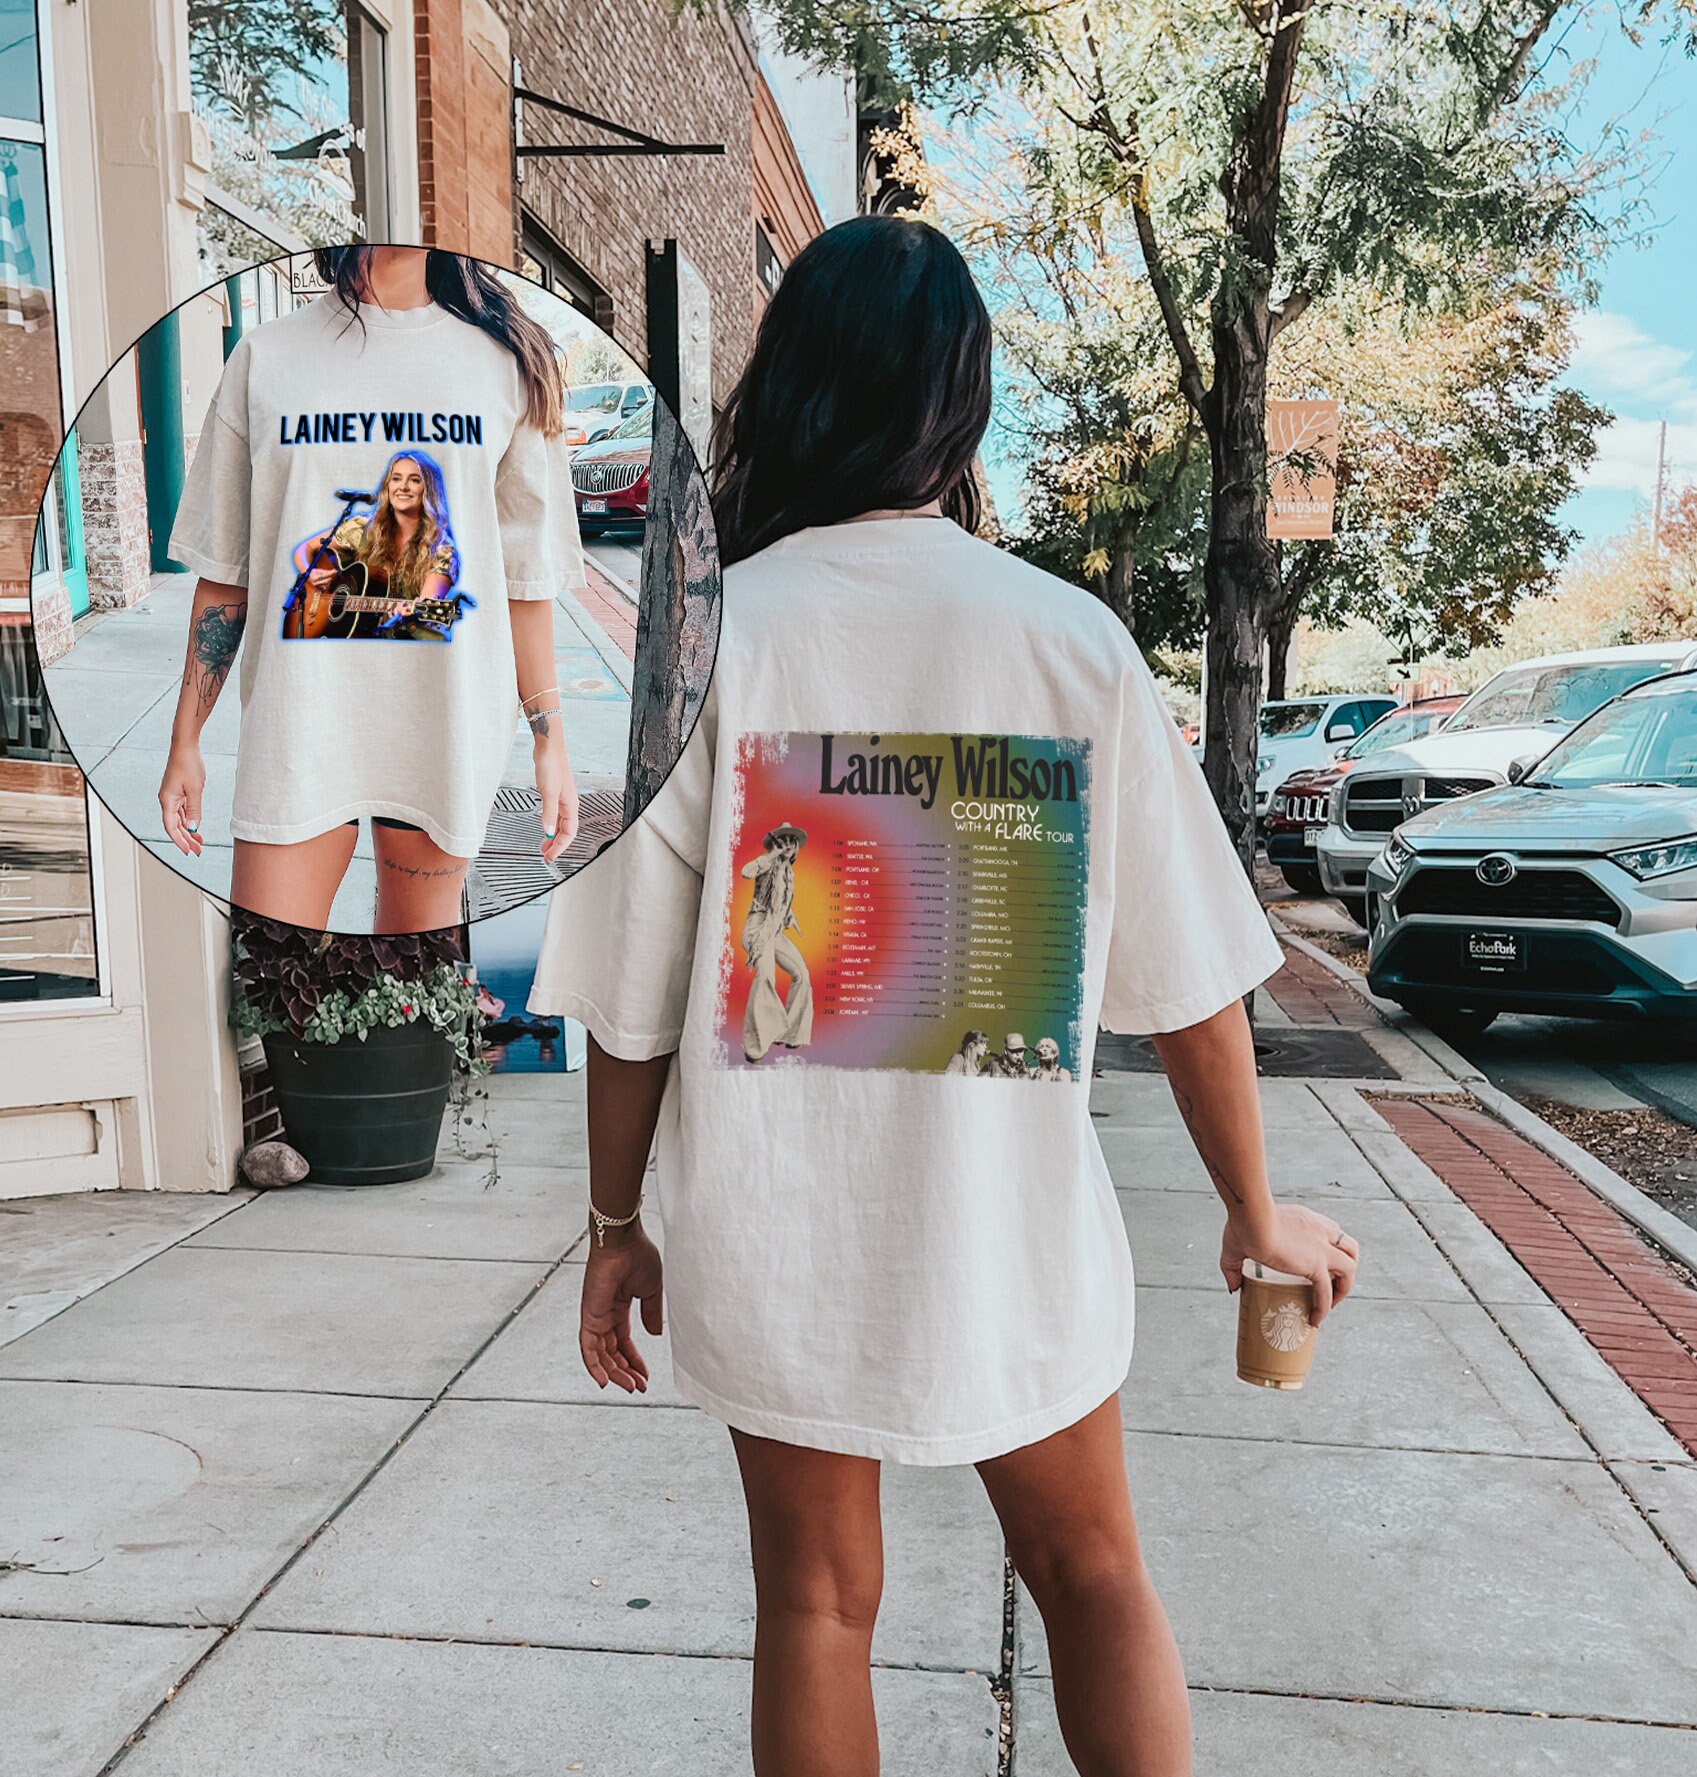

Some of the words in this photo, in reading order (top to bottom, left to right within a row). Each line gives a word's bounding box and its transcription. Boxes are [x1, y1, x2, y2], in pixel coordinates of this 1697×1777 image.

[293, 272, 328, 288] BLAC
[280, 412, 377, 445] LAINEY
[381, 412, 483, 446] WILSON
[819, 734, 944, 810] Lainey
[951, 736, 1078, 802] Wilson
[951, 801, 1040, 822] COUNTRY
[955, 821, 982, 833] WITH
[984, 823, 991, 833] A
[995, 823, 1042, 842] FLARE
[1045, 831, 1074, 844] TOUR
[1470, 940, 1517, 955] EchoPark
